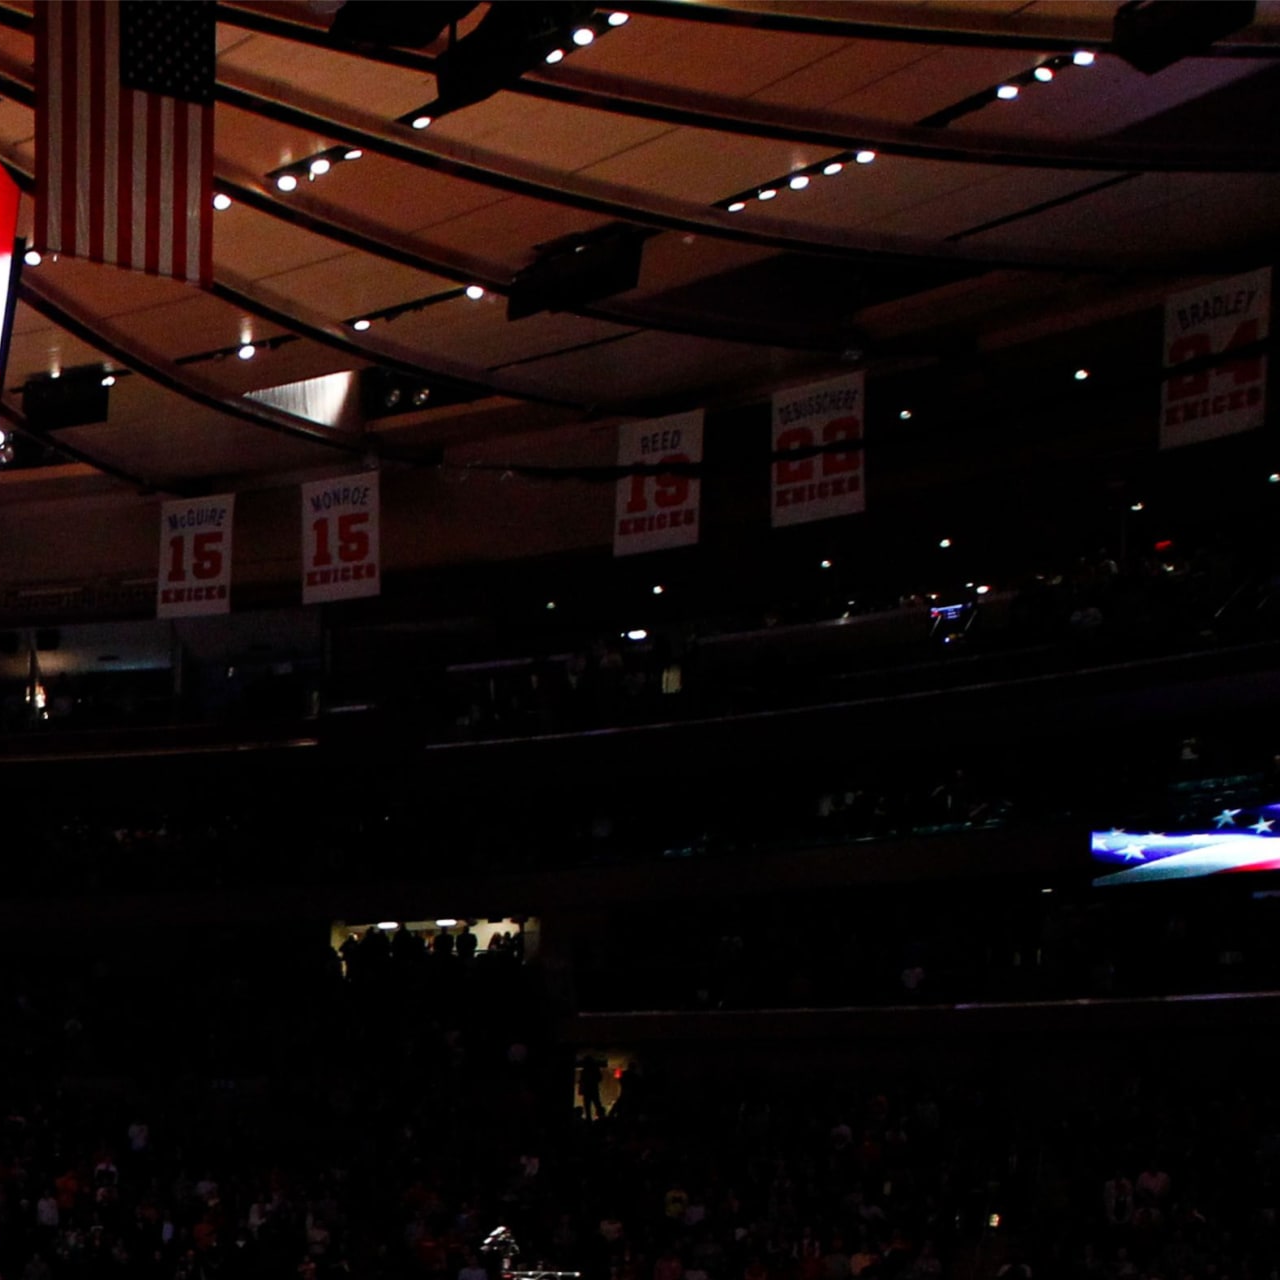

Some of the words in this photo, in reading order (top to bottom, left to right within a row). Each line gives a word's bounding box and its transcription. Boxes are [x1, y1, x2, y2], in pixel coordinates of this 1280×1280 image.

[1178, 289, 1257, 330] BRADLEY
[1168, 318, 1260, 402] 24
[641, 429, 681, 454] REED
[310, 487, 370, 511] MONROE
[627, 453, 689, 513] 19
[168, 532, 223, 581] 15
[313, 513, 369, 566] 15
